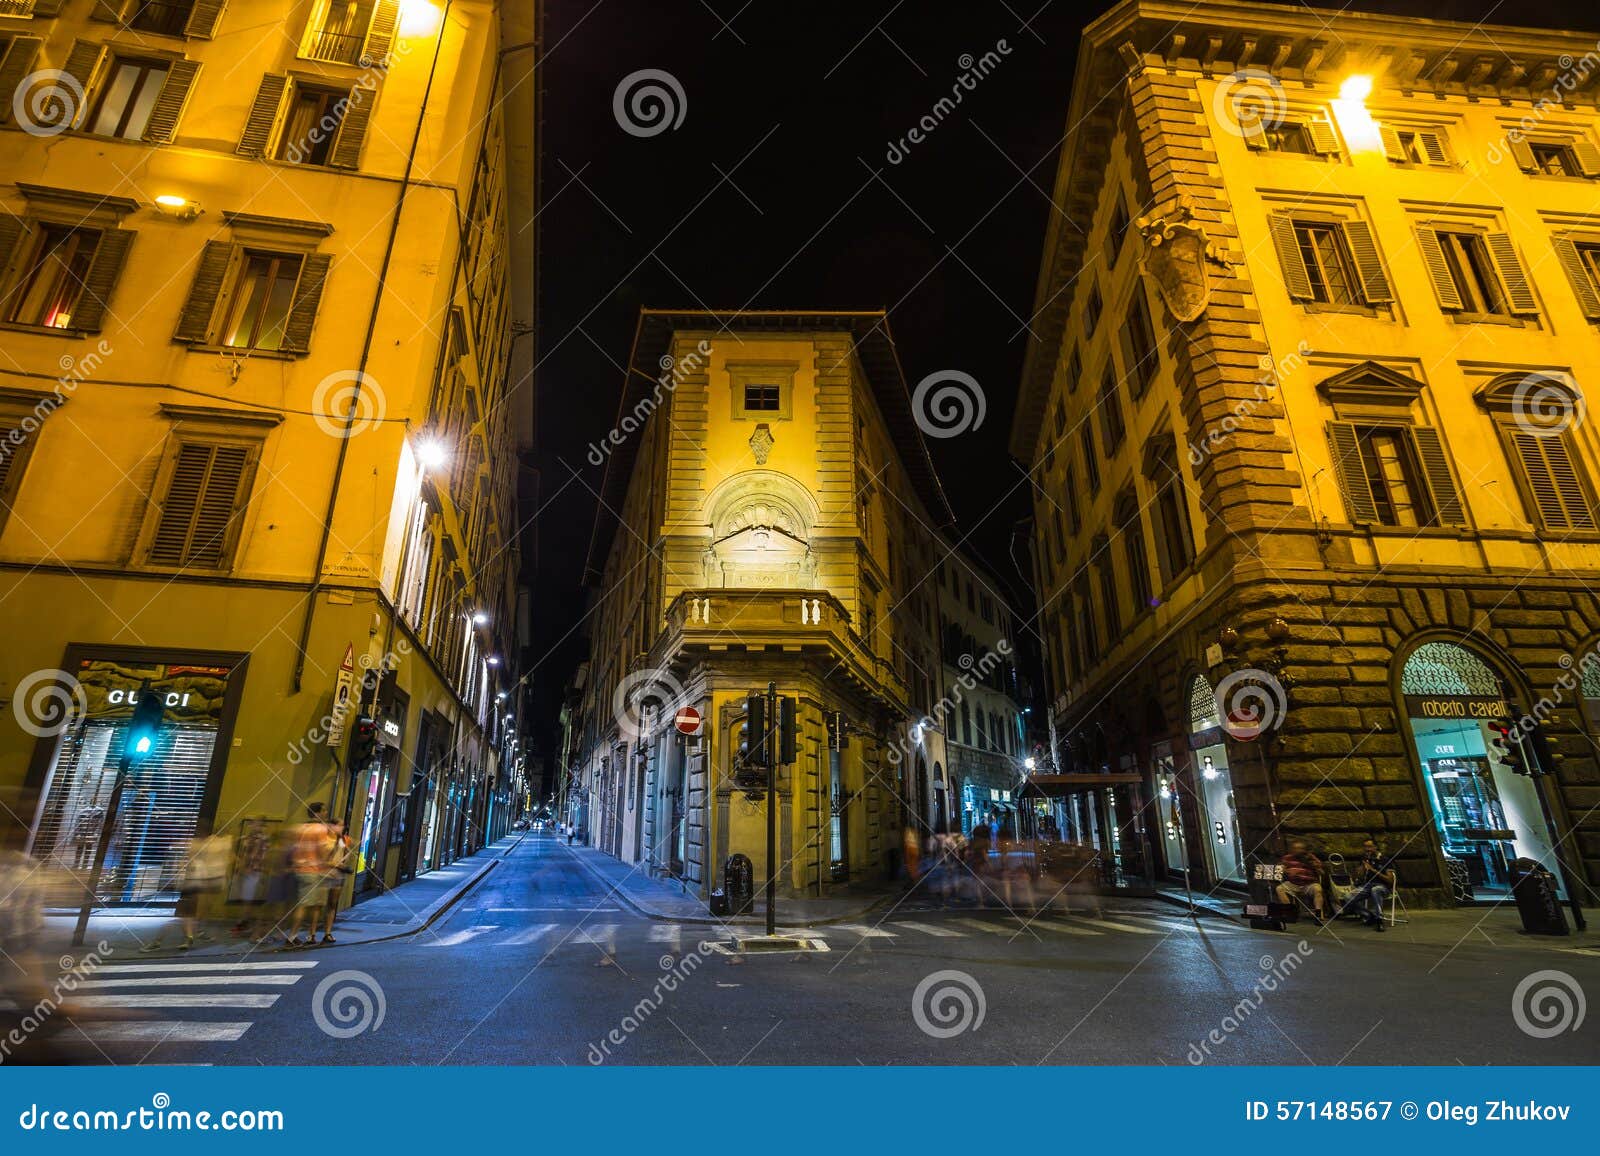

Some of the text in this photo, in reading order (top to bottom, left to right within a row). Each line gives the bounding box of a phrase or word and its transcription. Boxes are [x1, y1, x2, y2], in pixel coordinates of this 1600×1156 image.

[108, 689, 190, 707] GUCI
[1422, 699, 1508, 718] roberto cavall
